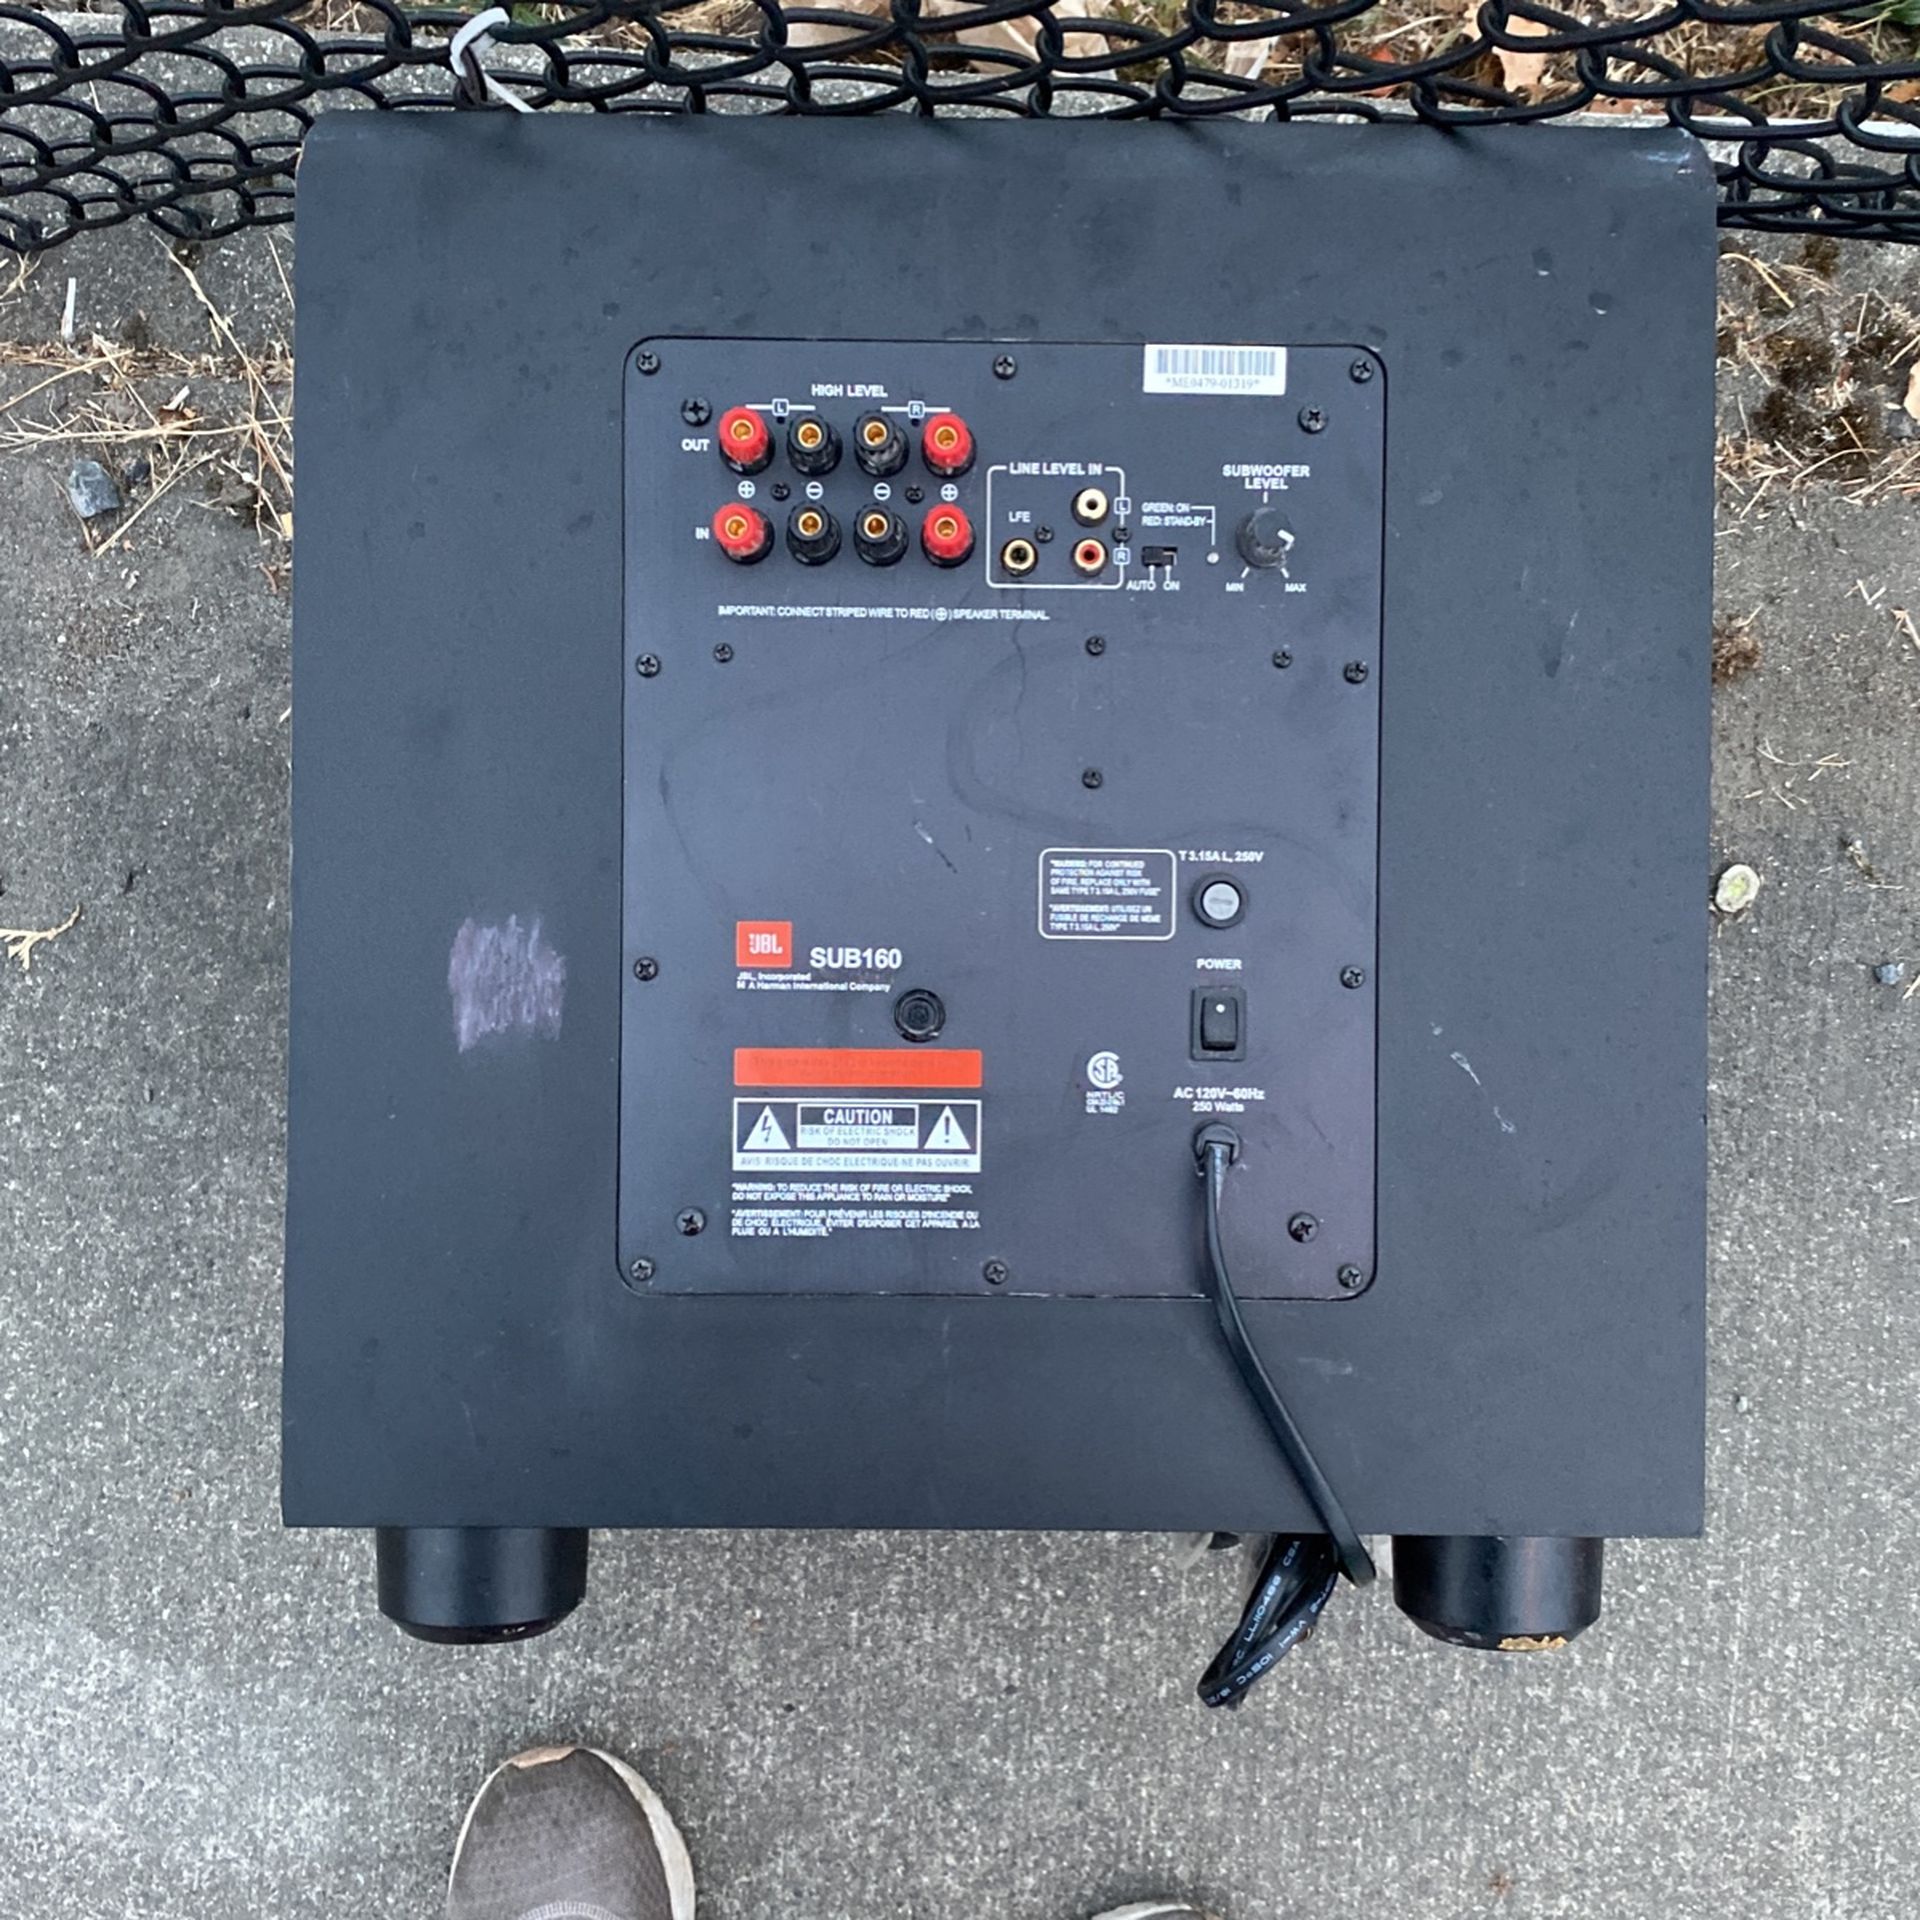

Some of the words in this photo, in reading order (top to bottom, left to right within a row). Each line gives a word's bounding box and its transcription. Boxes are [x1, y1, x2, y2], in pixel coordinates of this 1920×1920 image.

[811, 384, 843, 397] HIGH
[847, 385, 888, 398] LEVEL
[681, 439, 710, 451] OUT
[1009, 463, 1039, 474] LINE
[1042, 463, 1085, 475] LEVEL
[1088, 464, 1103, 475] IN
[1222, 465, 1310, 478] SUBWOOFER
[1245, 477, 1288, 490] LEVEL
[1175, 502, 1191, 513] ON
[1008, 511, 1031, 523] LFE
[1164, 515, 1206, 527] STAND-BY
[695, 528, 710, 540] IN
[1126, 580, 1157, 591] AUTO
[1163, 580, 1180, 591] ON
[1225, 582, 1244, 593] MIN
[1285, 583, 1307, 594] MAX
[776, 606, 825, 617] CONNECT
[825, 606, 867, 618] STRIPED
[868, 607, 894, 618] WIRE
[895, 607, 909, 618] TO
[953, 608, 998, 620] SPEAKER
[1178, 850, 1187, 861] T
[1188, 850, 1220, 861] 3.15A
[1235, 851, 1264, 862] 250V
[748, 933, 783, 955] JBL
[809, 946, 902, 969] SUB160
[1196, 958, 1242, 970] POWER
[758, 972, 812, 983] Incorporated
[748, 982, 756, 990] A
[757, 982, 791, 990] Harman
[793, 981, 848, 991] International
[848, 982, 891, 993] Company
[1173, 1086, 1194, 1099] AC
[1192, 1101, 1212, 1112] 250
[1214, 1101, 1245, 1113] Watts
[823, 1108, 893, 1125] CAUTION
[800, 1126, 821, 1135] RISK
[823, 1127, 835, 1136] OF
[837, 1127, 882, 1136] ELECTRIC
[884, 1127, 915, 1136] SHOCK
[827, 1137, 840, 1146] DO
[843, 1137, 862, 1146] NOT
[864, 1137, 888, 1146] OPEN
[765, 1156, 799, 1166] RISQUE
[802, 1157, 813, 1166] DE
[816, 1157, 841, 1166] CHOC
[901, 1158, 914, 1167] NE
[916, 1158, 933, 1167] PAS
[777, 1183, 788, 1192] TO
[789, 1183, 822, 1192] REDUCE
[823, 1183, 838, 1192] THE
[840, 1183, 858, 1192] RISK
[860, 1183, 871, 1192] OF
[871, 1184, 889, 1193] FIRE
[891, 1184, 903, 1193] OR
[904, 1184, 942, 1193] ELECTRIC
[732, 1192, 745, 1201] DO
[746, 1192, 762, 1201] NOT
[764, 1192, 797, 1201] EXPOSE
[798, 1192, 815, 1201] THIS
[816, 1192, 860, 1201] APPLIANCE
[862, 1193, 872, 1202] TO
[873, 1193, 893, 1202] RAIN
[894, 1193, 906, 1202] OR
[804, 1209, 827, 1218] POUR
[868, 1209, 884, 1219] LES
[885, 1209, 920, 1219] RISQUES
[965, 1210, 979, 1220] OU
[731, 1218, 742, 1227] DE
[744, 1218, 768, 1227] CHOC
[904, 1219, 920, 1229] CET
[731, 1227, 755, 1236] PLUIE
[757, 1227, 771, 1236] OU
[1282, 1541, 1301, 1567] CSA
[1279, 1620, 1307, 1648] VW-1
